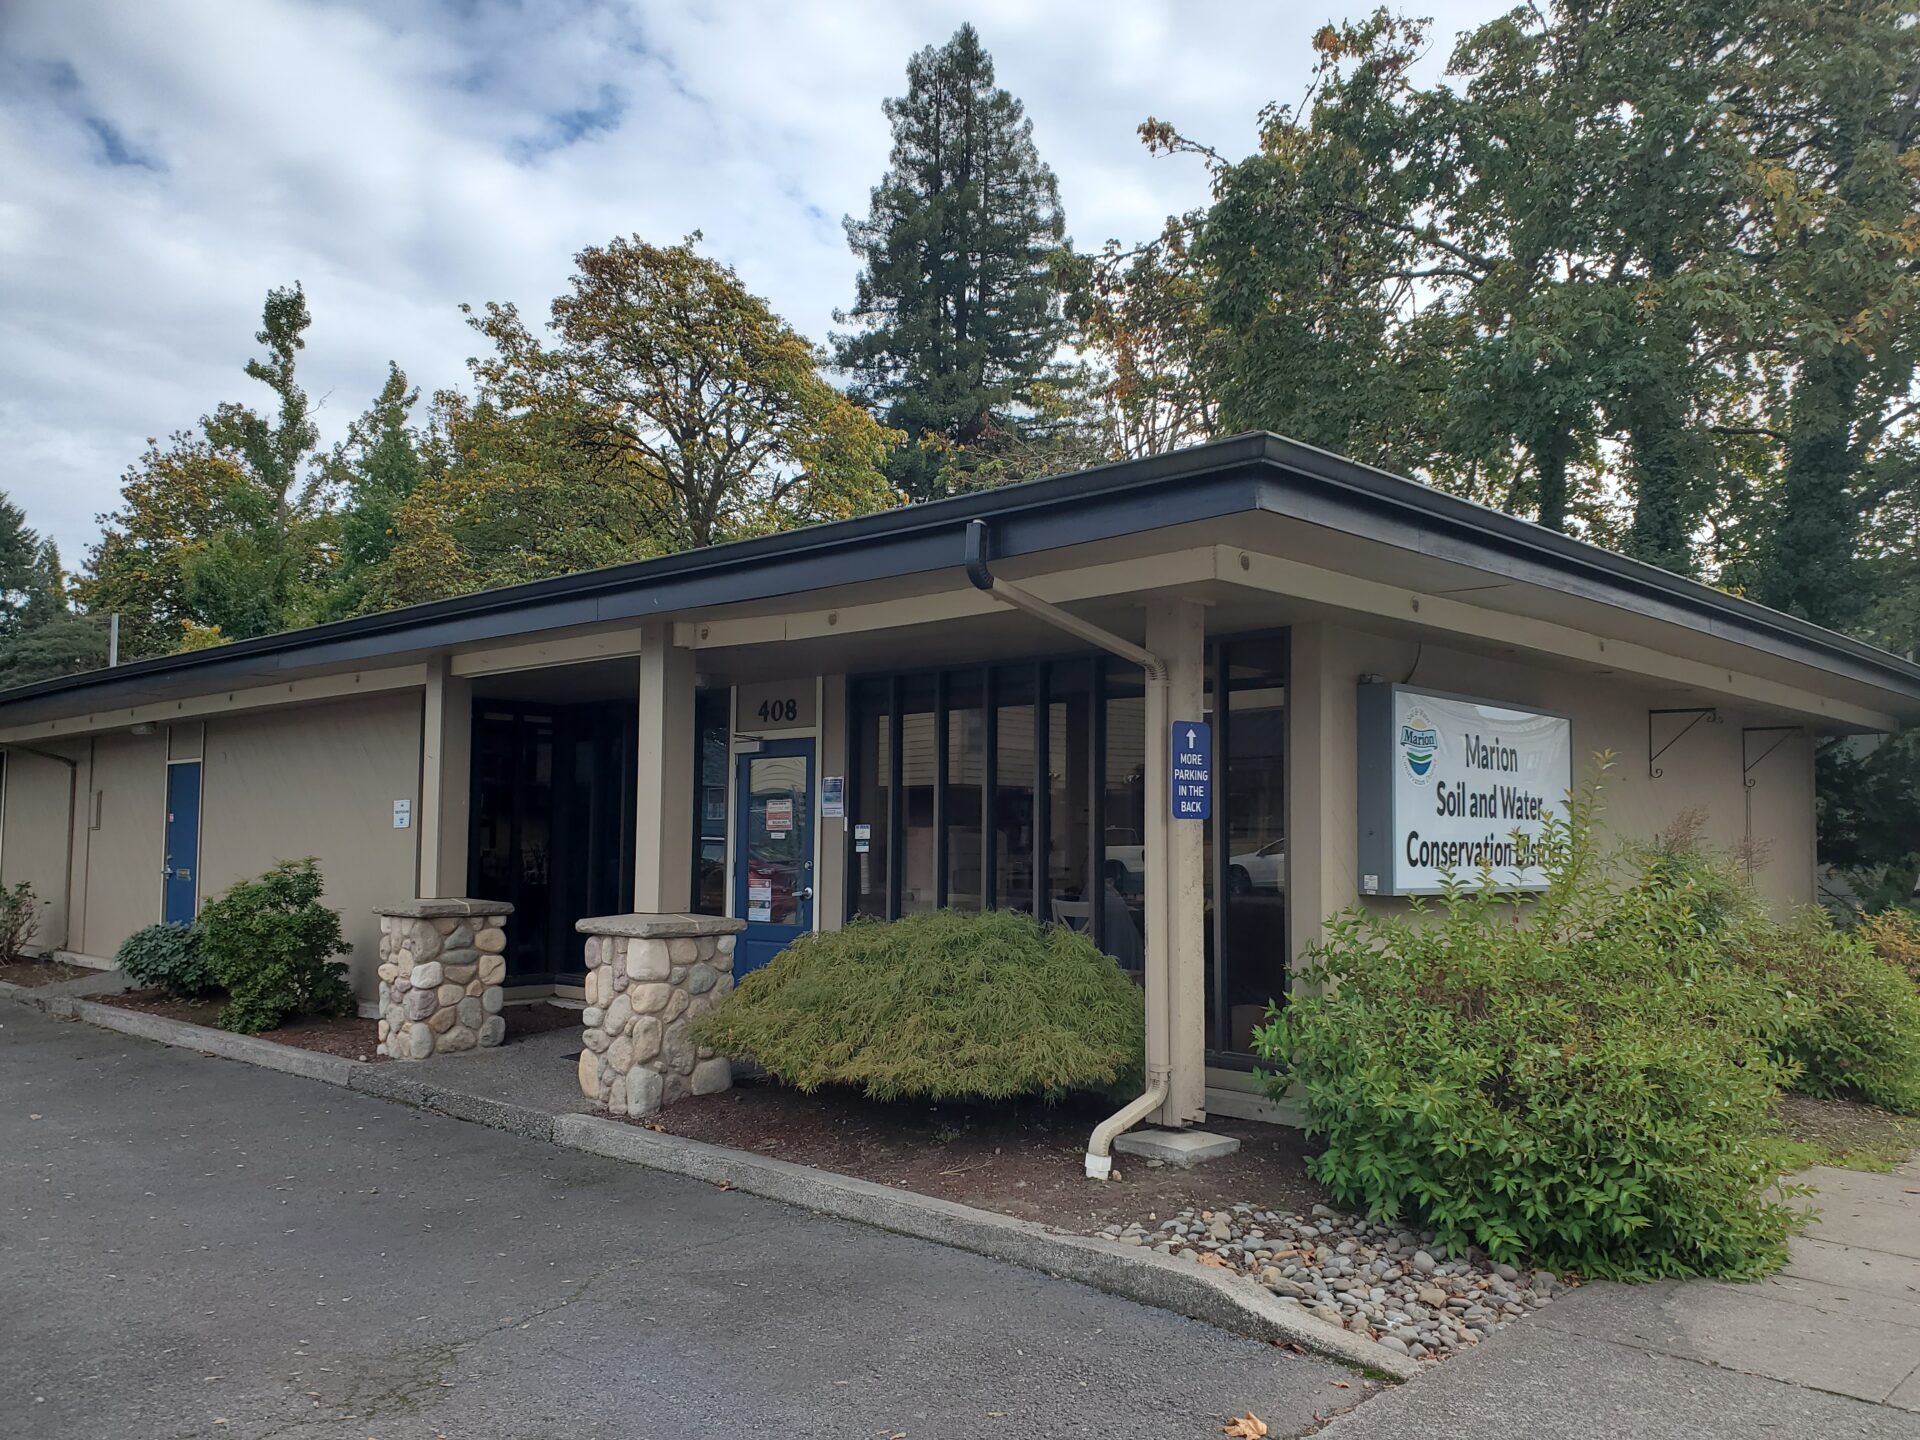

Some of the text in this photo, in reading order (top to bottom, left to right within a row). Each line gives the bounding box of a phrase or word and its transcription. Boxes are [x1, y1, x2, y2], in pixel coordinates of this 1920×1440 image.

[758, 699, 797, 722] 408
[1404, 729, 1435, 745] Marion
[1180, 753, 1202, 765] MORE
[1465, 734, 1518, 772] Marion
[1174, 769, 1208, 781] PARKING
[1178, 785, 1204, 796] IN THE
[1181, 801, 1202, 813] BACK
[1437, 781, 1544, 820] Soil and Water
[1406, 831, 1564, 867] Conservation Disit
